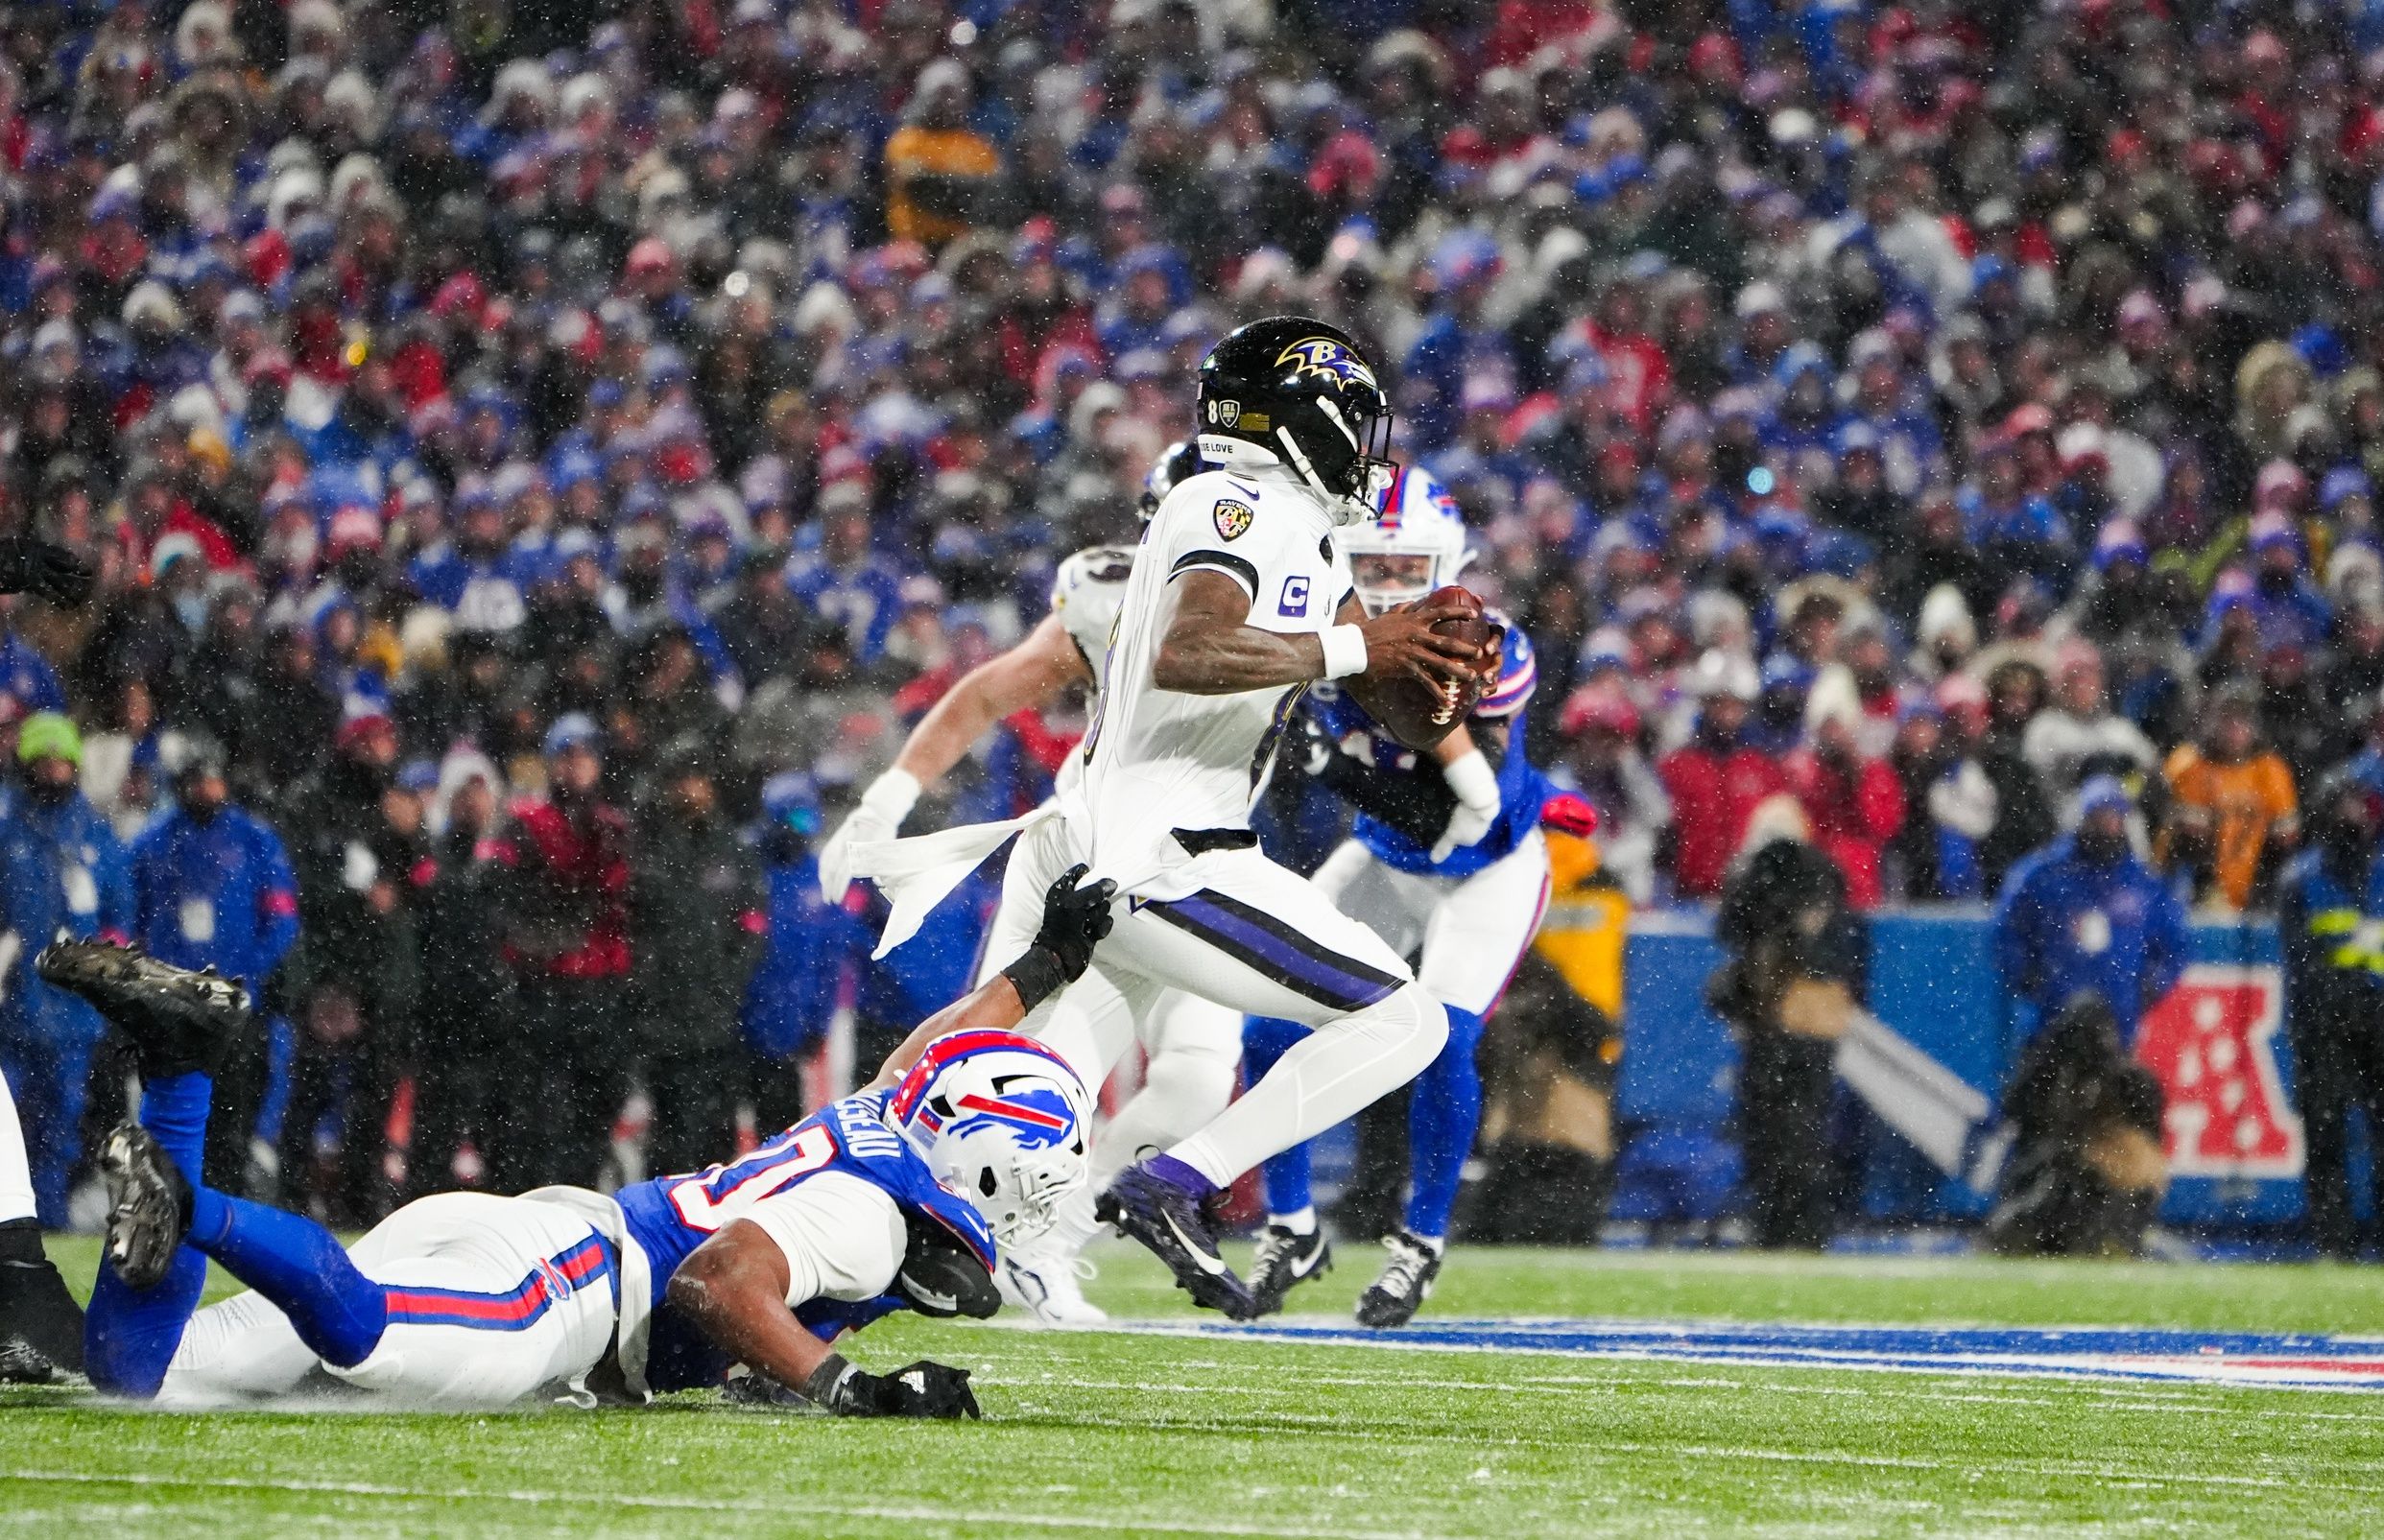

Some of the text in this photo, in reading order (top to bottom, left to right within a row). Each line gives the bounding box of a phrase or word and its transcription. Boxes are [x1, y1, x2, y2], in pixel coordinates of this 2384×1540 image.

[1306, 341, 1337, 365] B
[1207, 399, 1219, 424] 8
[1211, 443, 1234, 454] LOVE
[1282, 579, 1309, 607] C
[664, 1121, 839, 1235] 0
